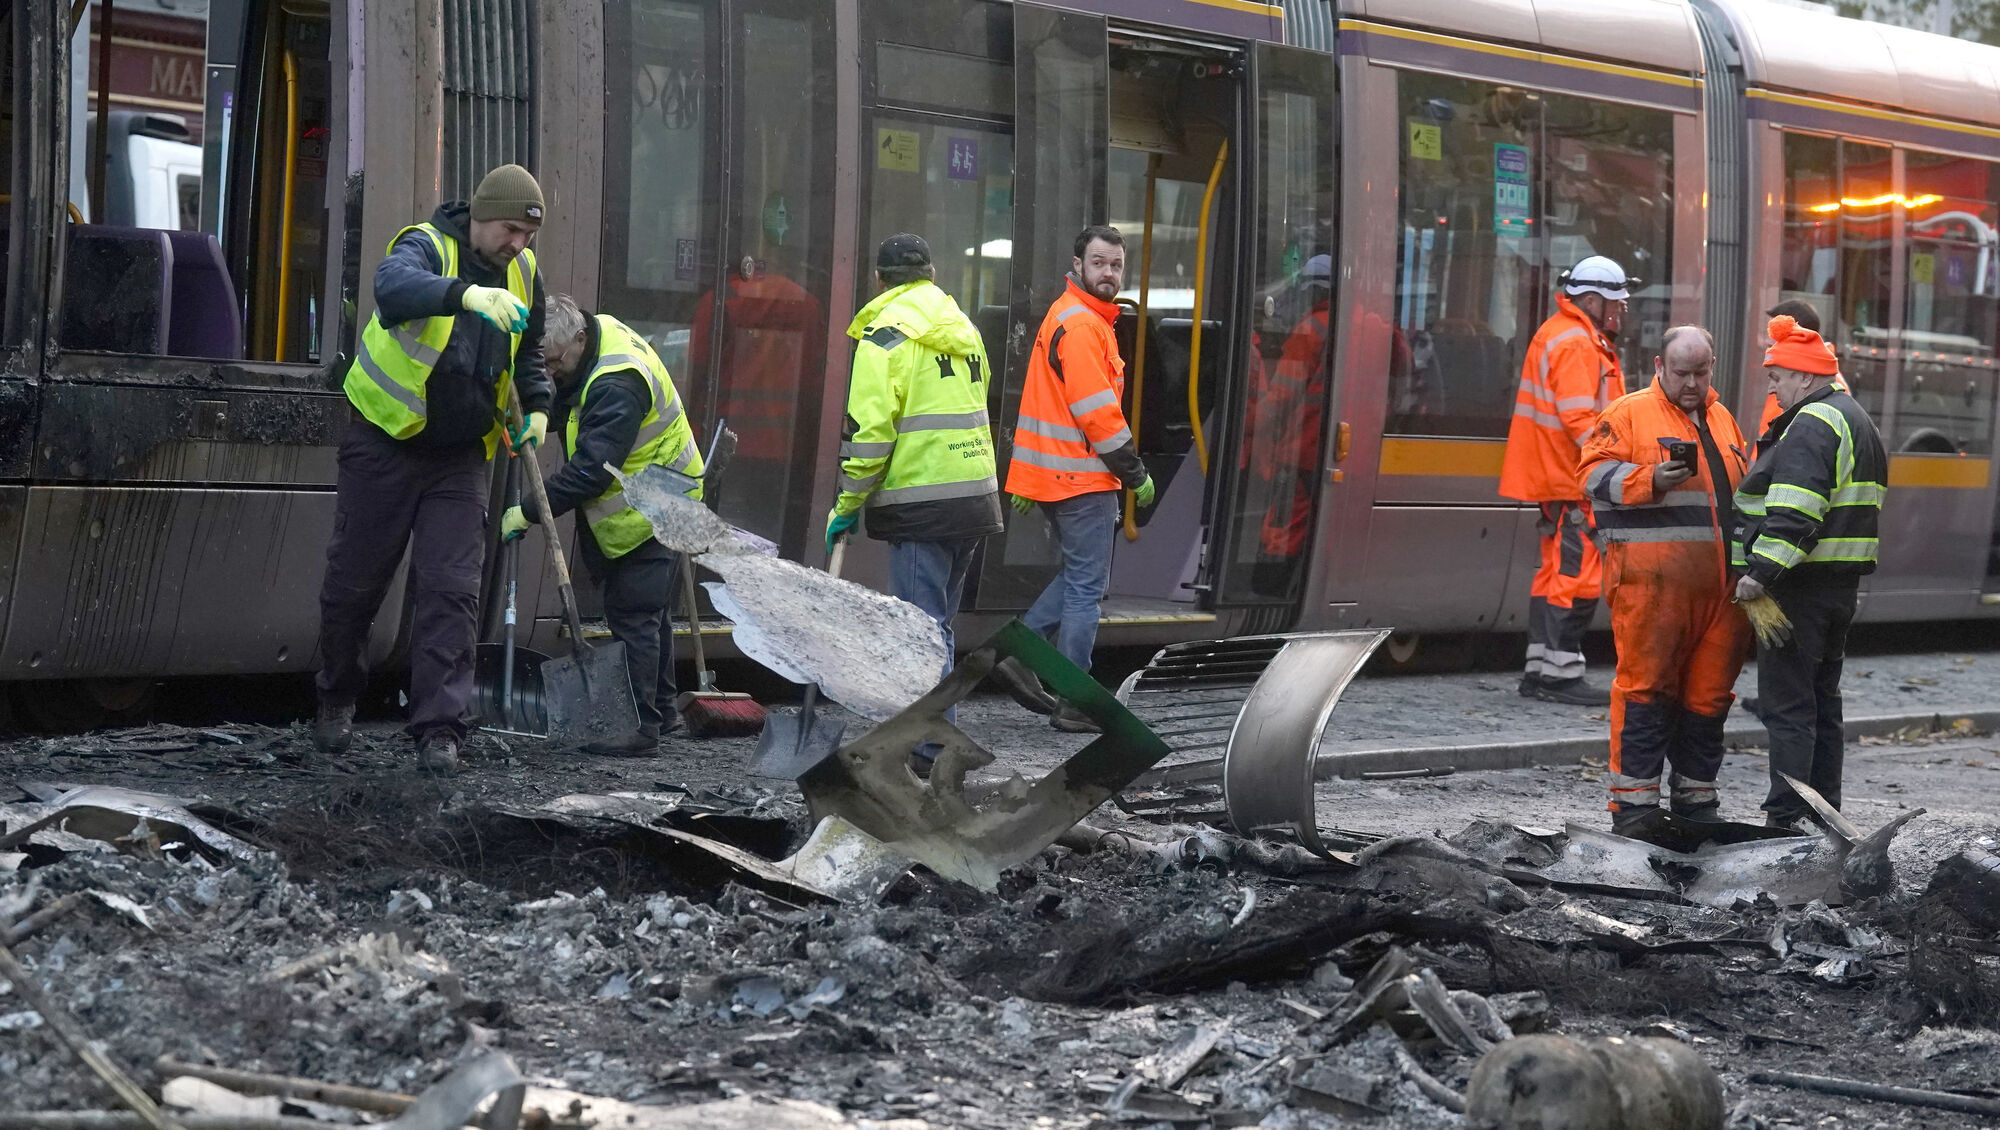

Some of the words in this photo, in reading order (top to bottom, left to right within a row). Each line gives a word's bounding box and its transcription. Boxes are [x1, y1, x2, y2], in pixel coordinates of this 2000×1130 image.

[150, 55, 206, 97] MA
[948, 440, 975, 450] Working
[963, 450, 980, 459] Dublin
